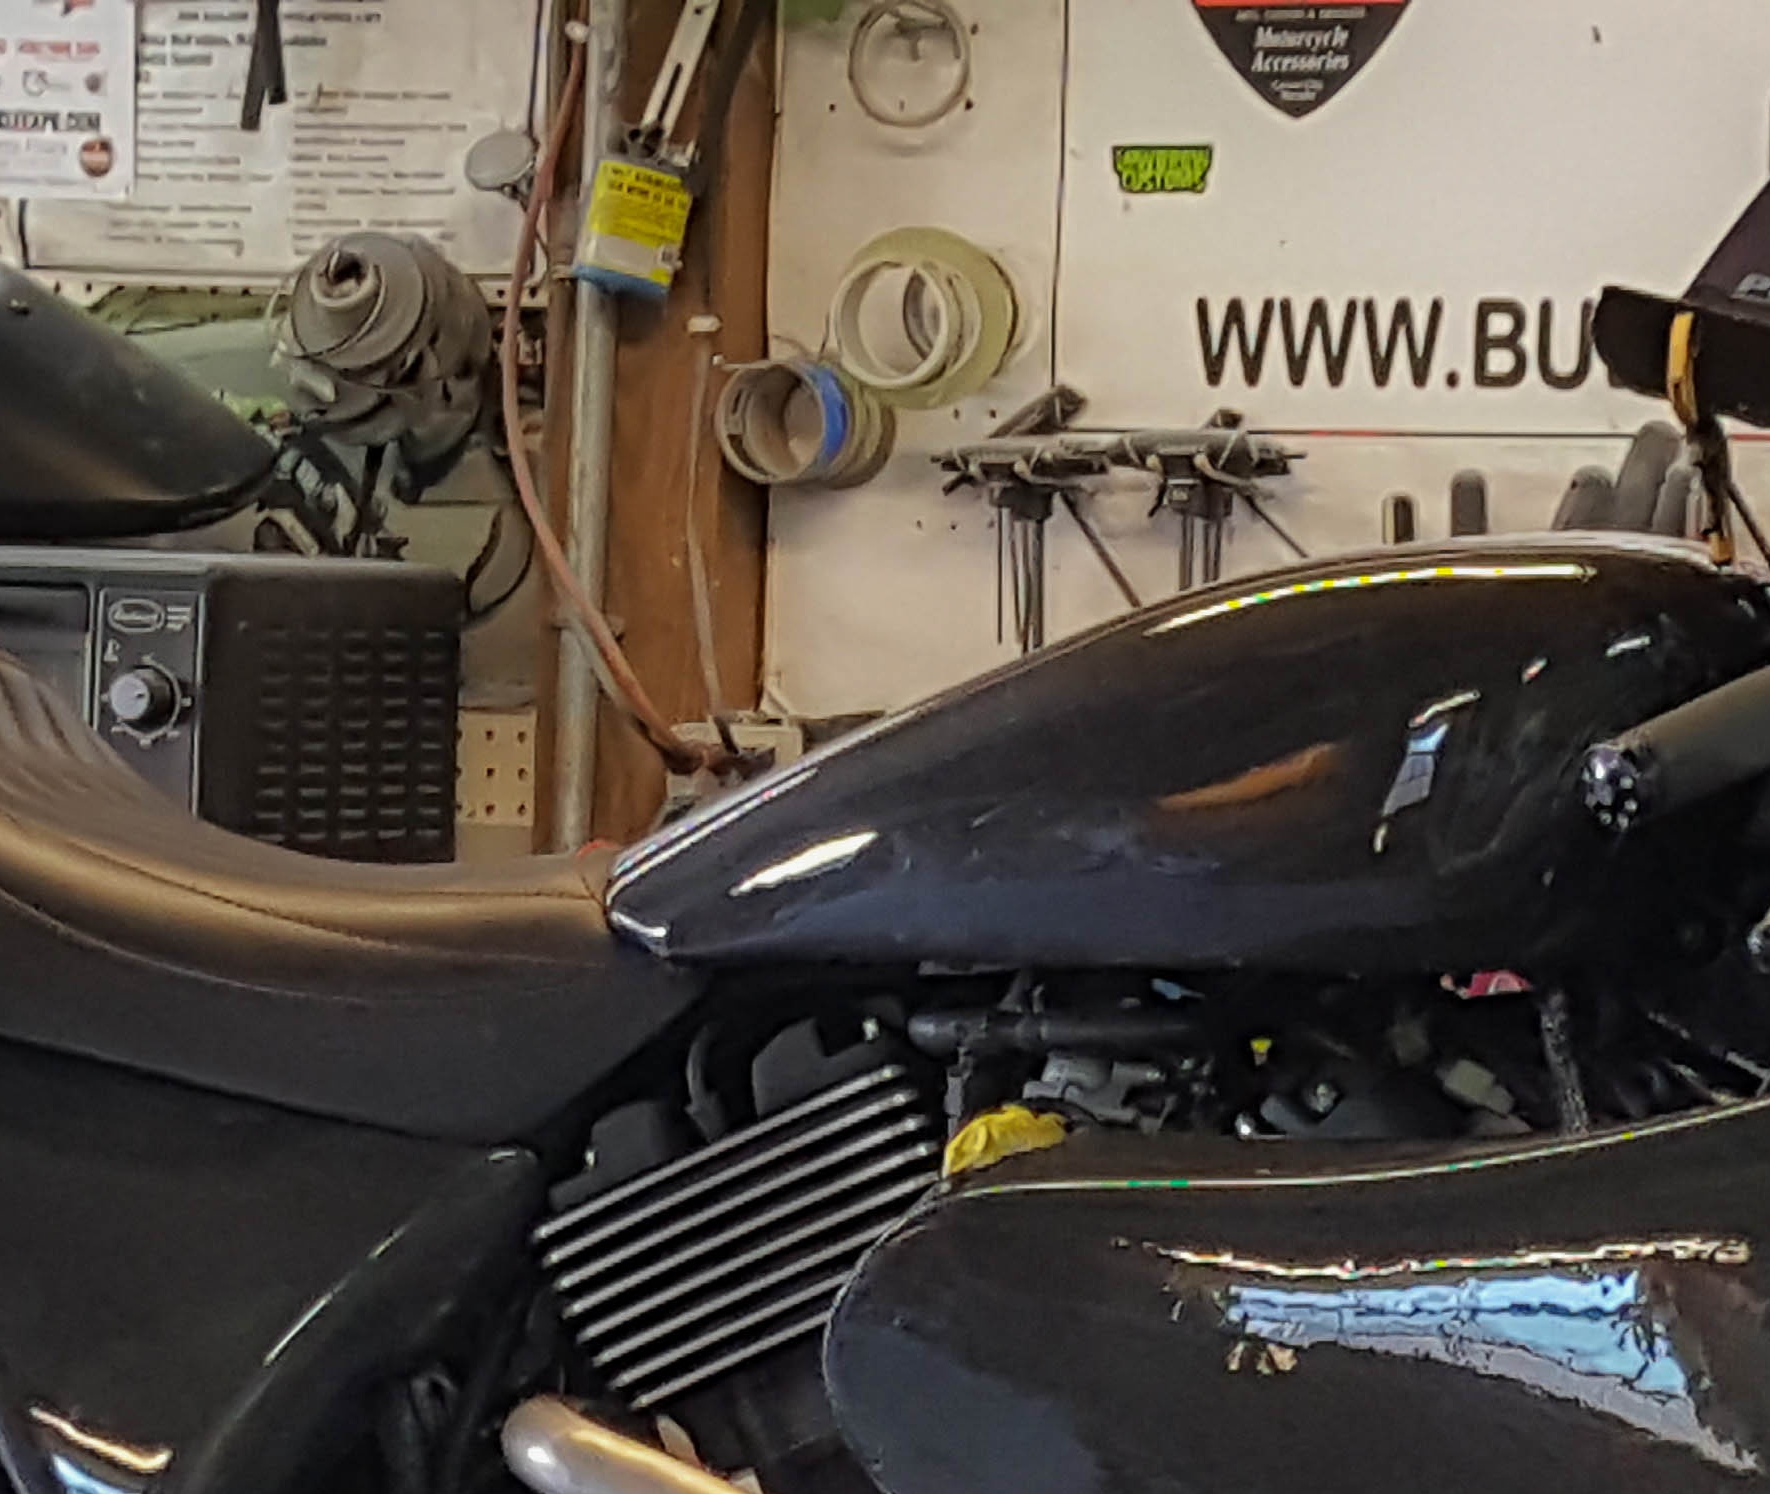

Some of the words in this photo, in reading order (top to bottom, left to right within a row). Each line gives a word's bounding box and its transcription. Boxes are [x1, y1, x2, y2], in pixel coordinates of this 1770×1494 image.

[1252, 25, 1351, 51] Motorcycle
[1250, 51, 1351, 73] Accessories
[1196, 297, 1593, 389] WWW.BU
